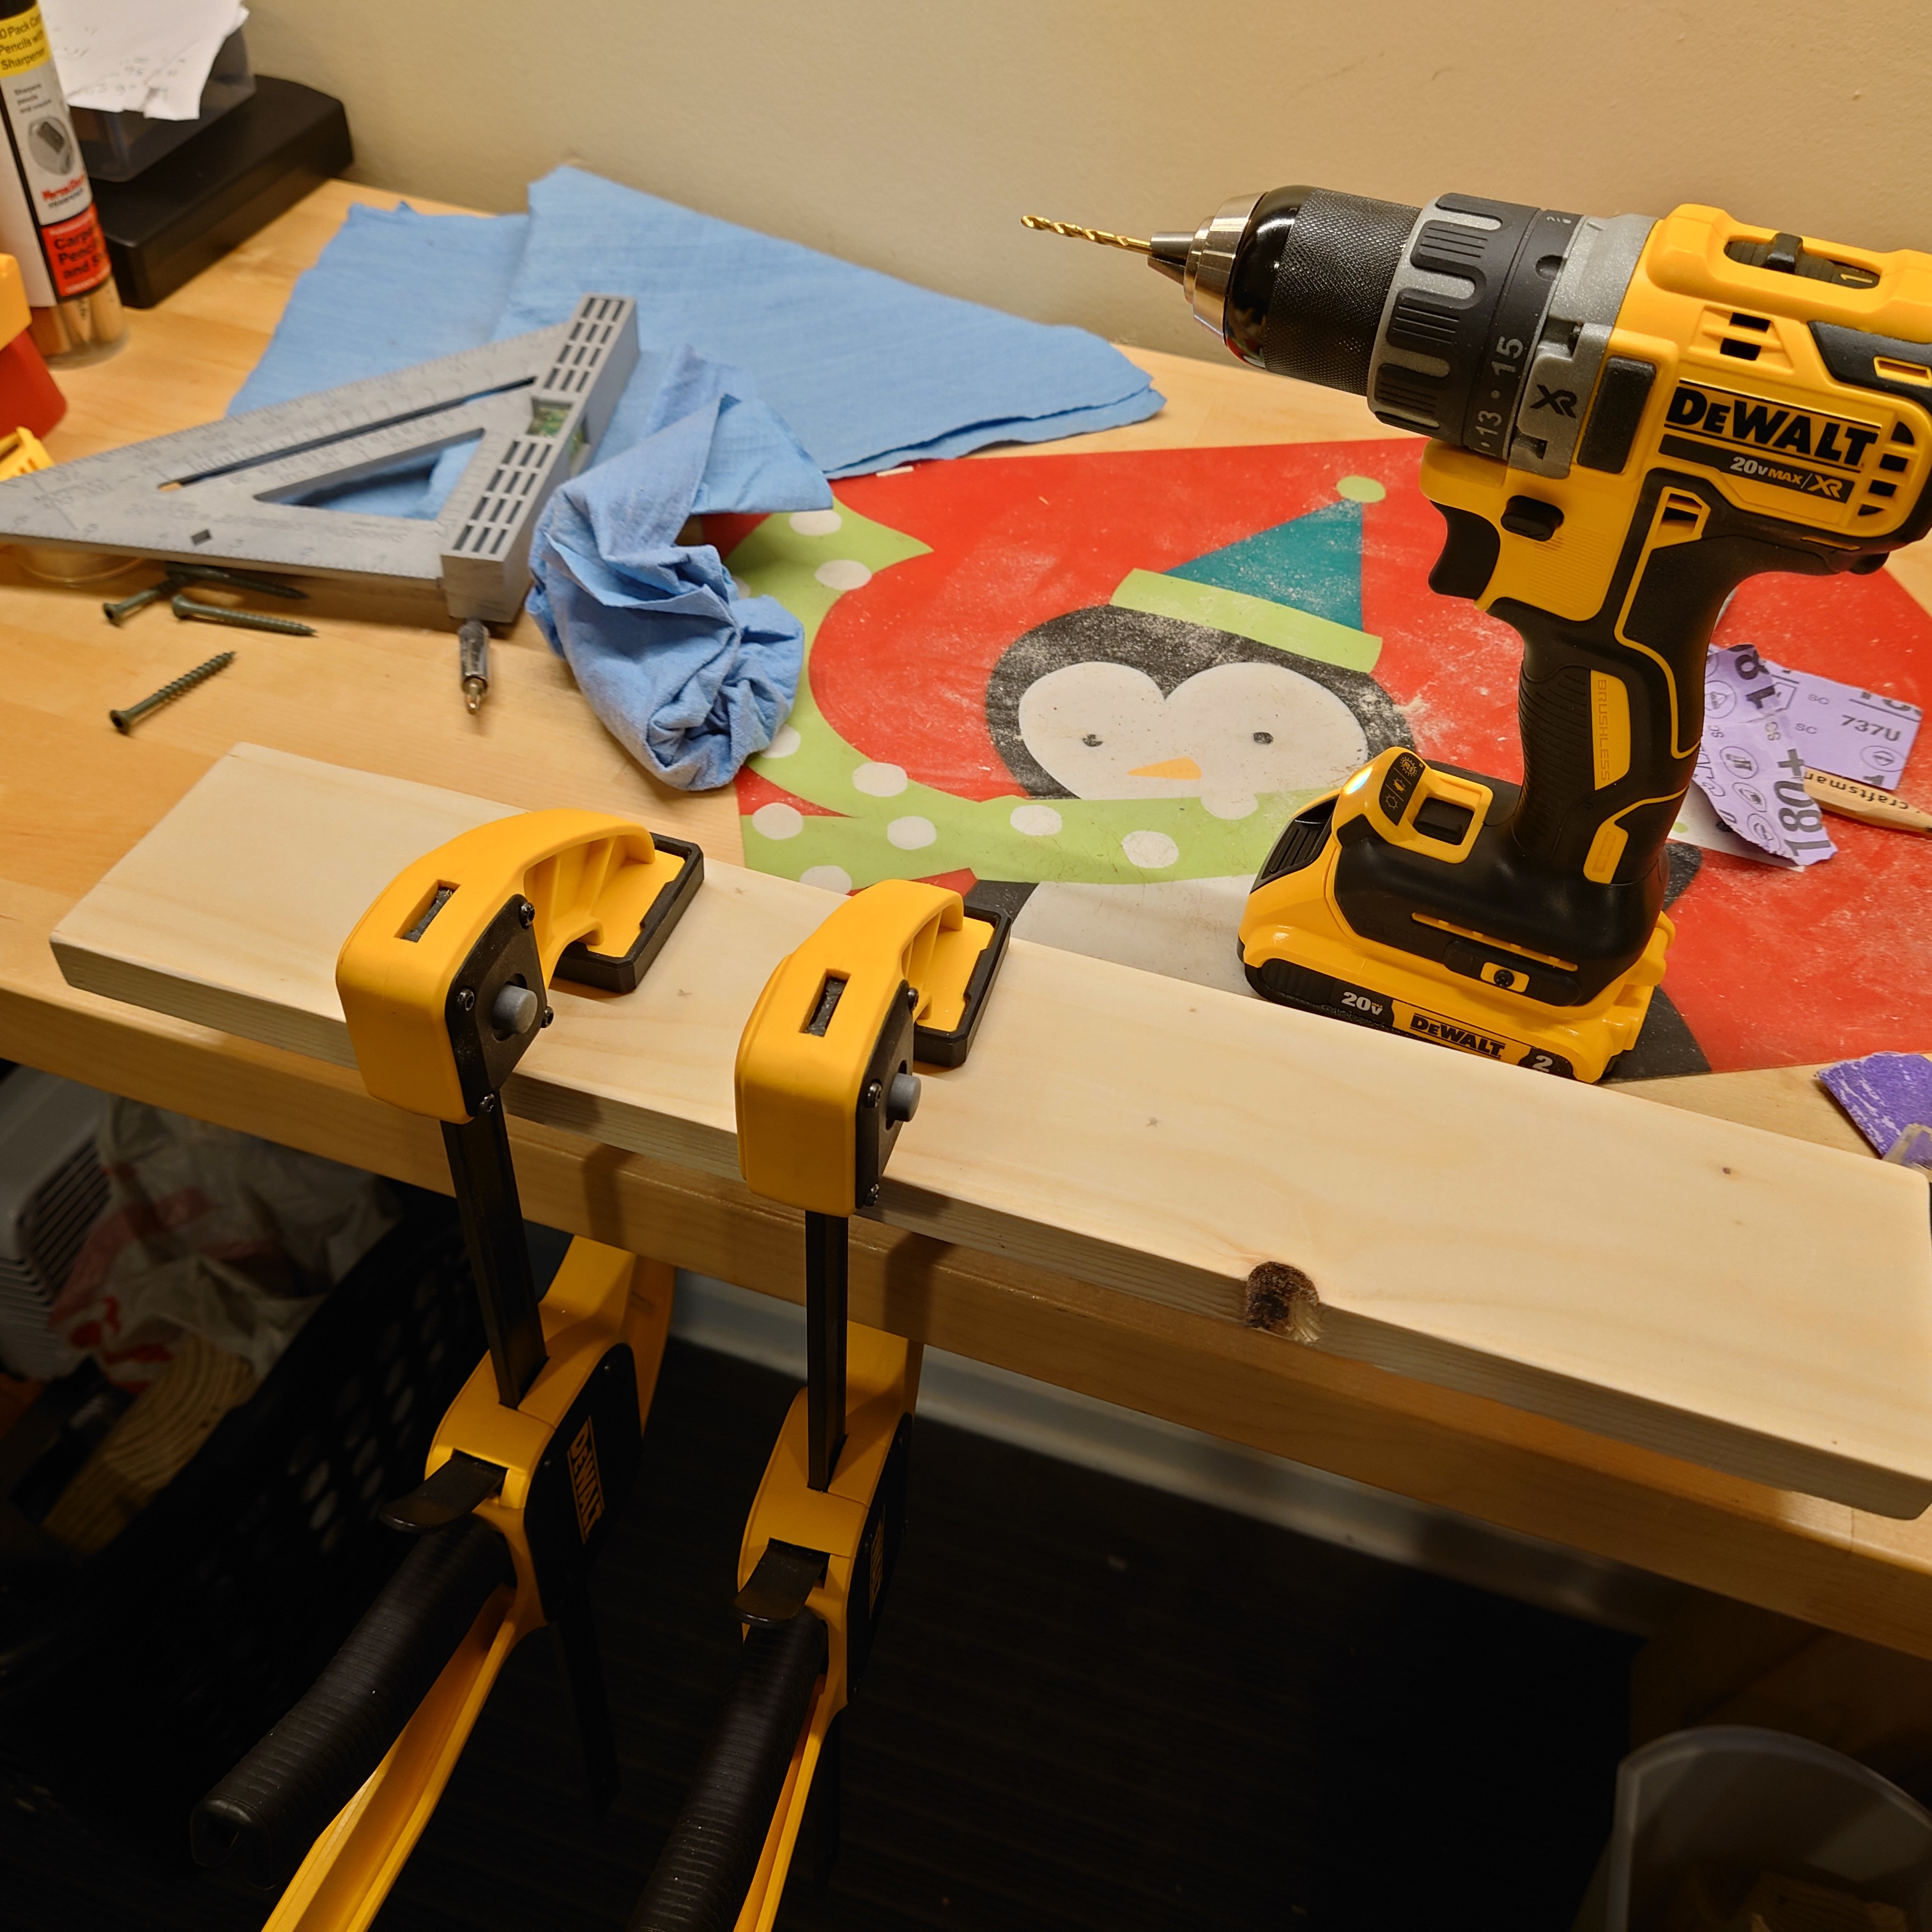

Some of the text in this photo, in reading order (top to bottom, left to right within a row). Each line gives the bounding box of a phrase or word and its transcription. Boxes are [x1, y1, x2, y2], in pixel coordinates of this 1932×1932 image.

[1839, 273, 1873, 284] 1
[1491, 335, 1524, 377] 15
[1530, 385, 1577, 418] XR
[1475, 410, 1502, 436] 13
[1768, 467, 1804, 485] MAX
[1807, 474, 1843, 498] XR
[1807, 693, 1830, 706] SC
[1597, 678, 1611, 781] BRUSHLESS
[1794, 723, 1818, 735] SC
[1841, 714, 1901, 742] 737U
[1532, 1055, 1553, 1073] 2
